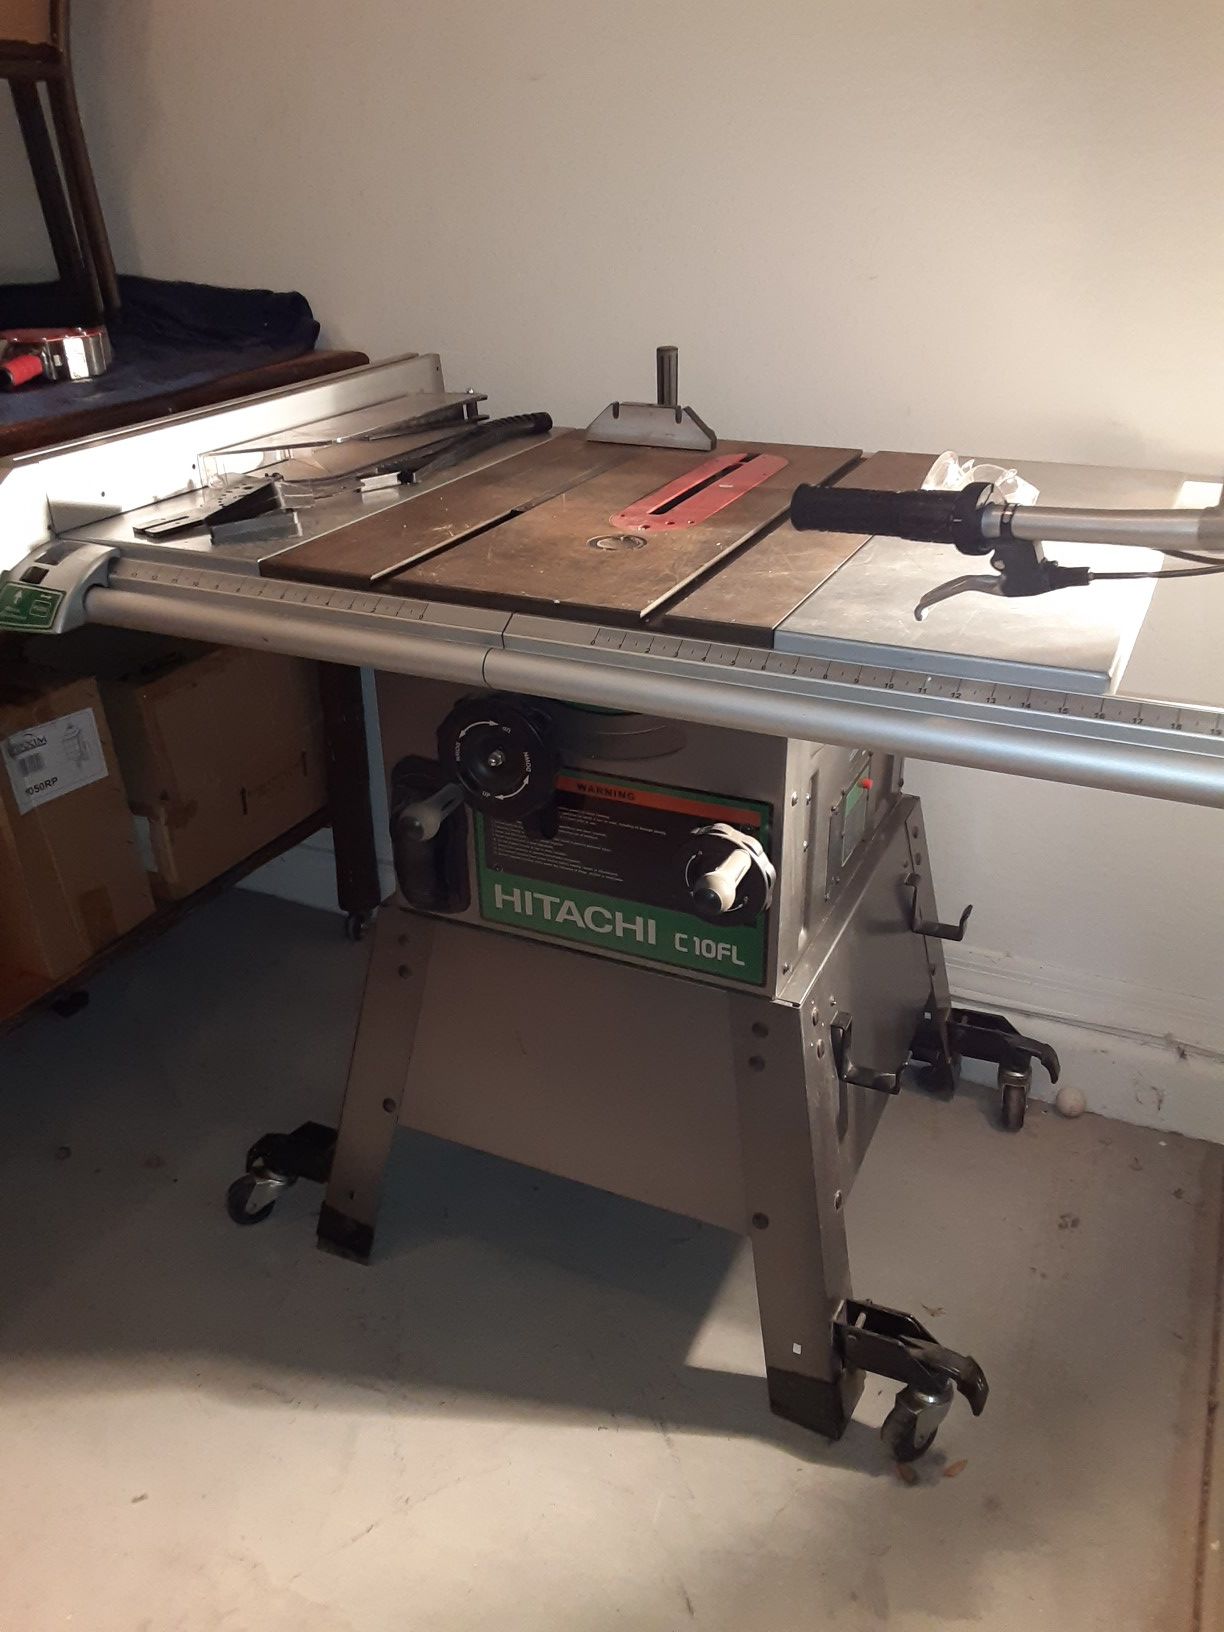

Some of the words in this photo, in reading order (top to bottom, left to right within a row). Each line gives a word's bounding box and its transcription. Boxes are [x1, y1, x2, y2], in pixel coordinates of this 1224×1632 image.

[951, 691, 961, 699] 12
[1057, 707, 1068, 715] 15
[1132, 717, 1143, 725] 17
[576, 783, 635, 800] WARNING
[494, 883, 657, 945] HITACHI
[674, 932, 688, 953] C
[692, 935, 746, 966] 10FL
